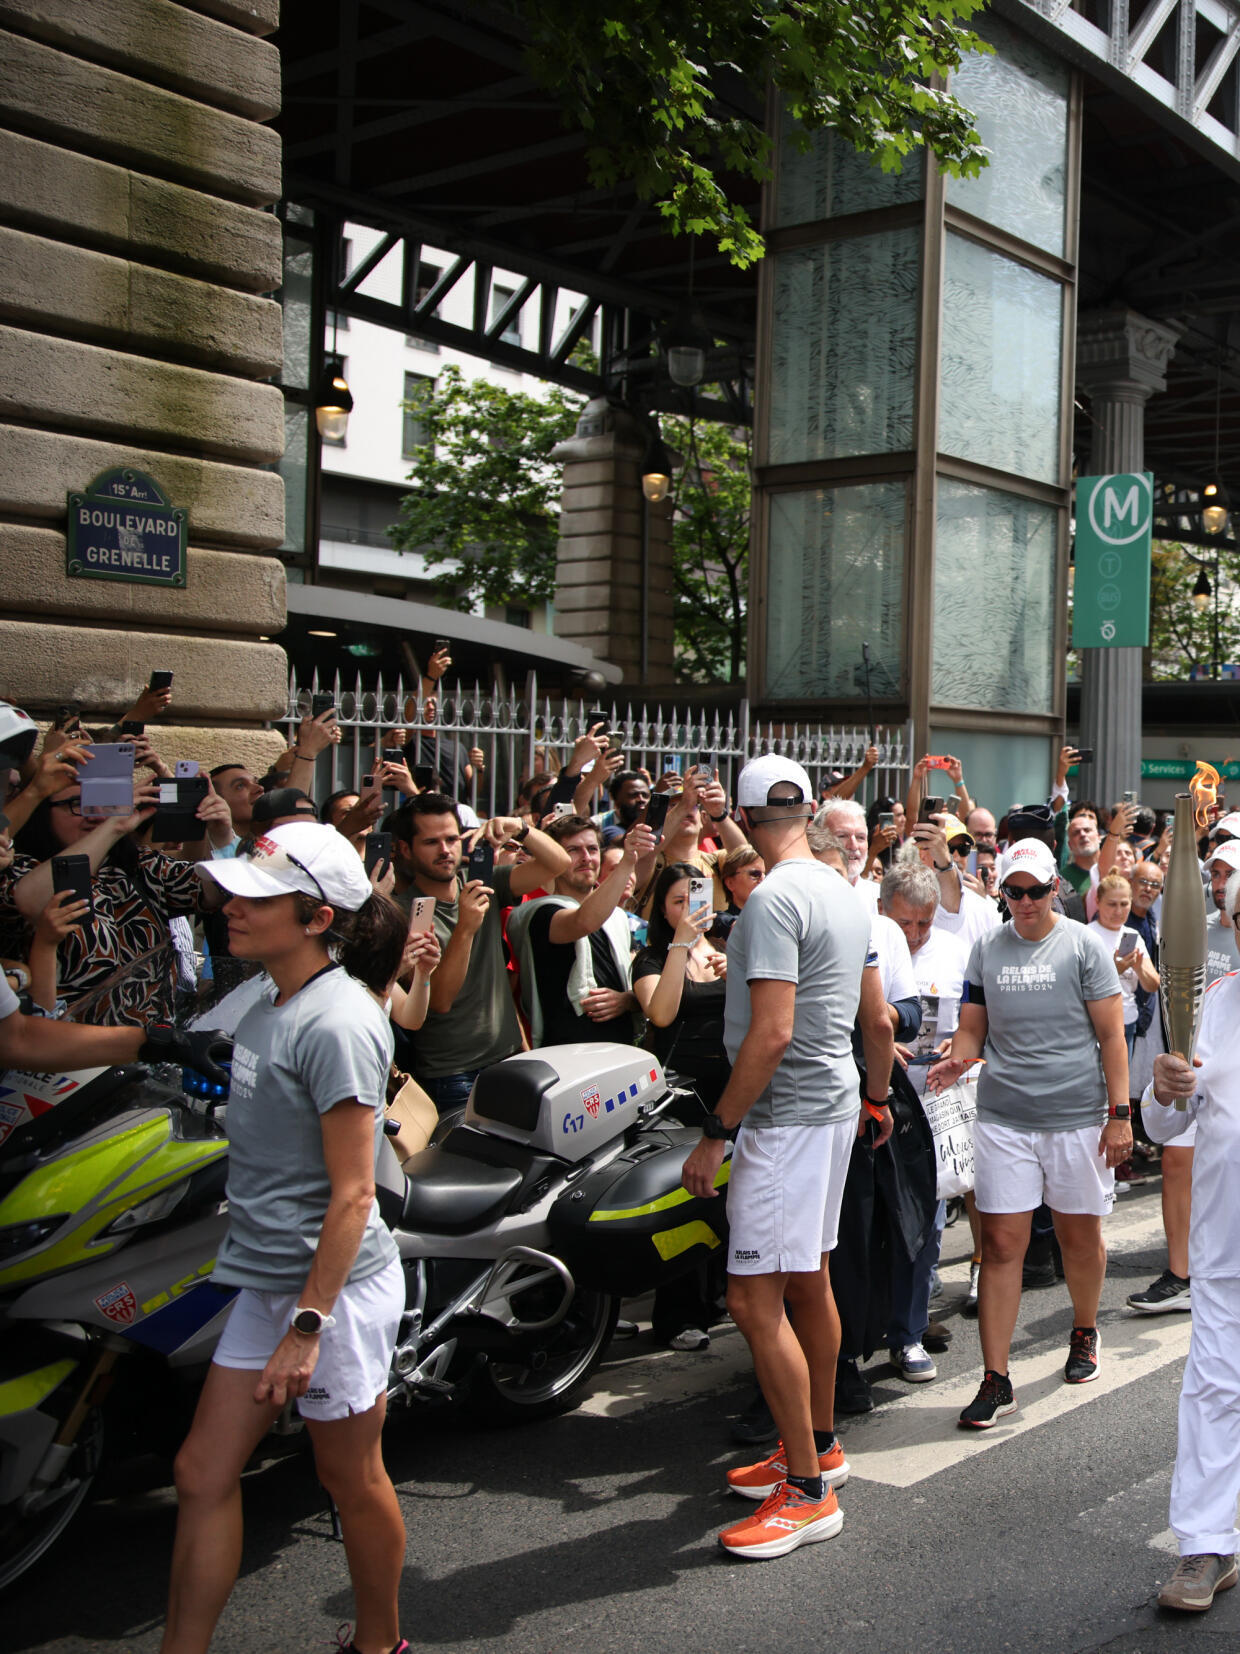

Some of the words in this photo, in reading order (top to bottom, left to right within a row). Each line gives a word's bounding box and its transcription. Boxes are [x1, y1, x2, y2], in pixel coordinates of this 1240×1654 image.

[1104, 485, 1139, 528] M
[80, 509, 178, 536] BOULEVARD
[87, 547, 171, 571] GRENELLE
[1148, 763, 1186, 775] Services
[1002, 966, 1037, 975] RELAIS
[1038, 964, 1052, 973] DE
[1208, 959, 1232, 972] AMME
[997, 975, 1010, 984] LA
[1012, 972, 1057, 984] FLAMME
[1027, 983, 1053, 991] 2024
[585, 1095, 599, 1108] CRS
[949, 1104, 961, 1115] QUI
[570, 1114, 584, 1133] 17
[951, 1110, 977, 1125] JAMAIS
[106, 1295, 134, 1315] CRS
